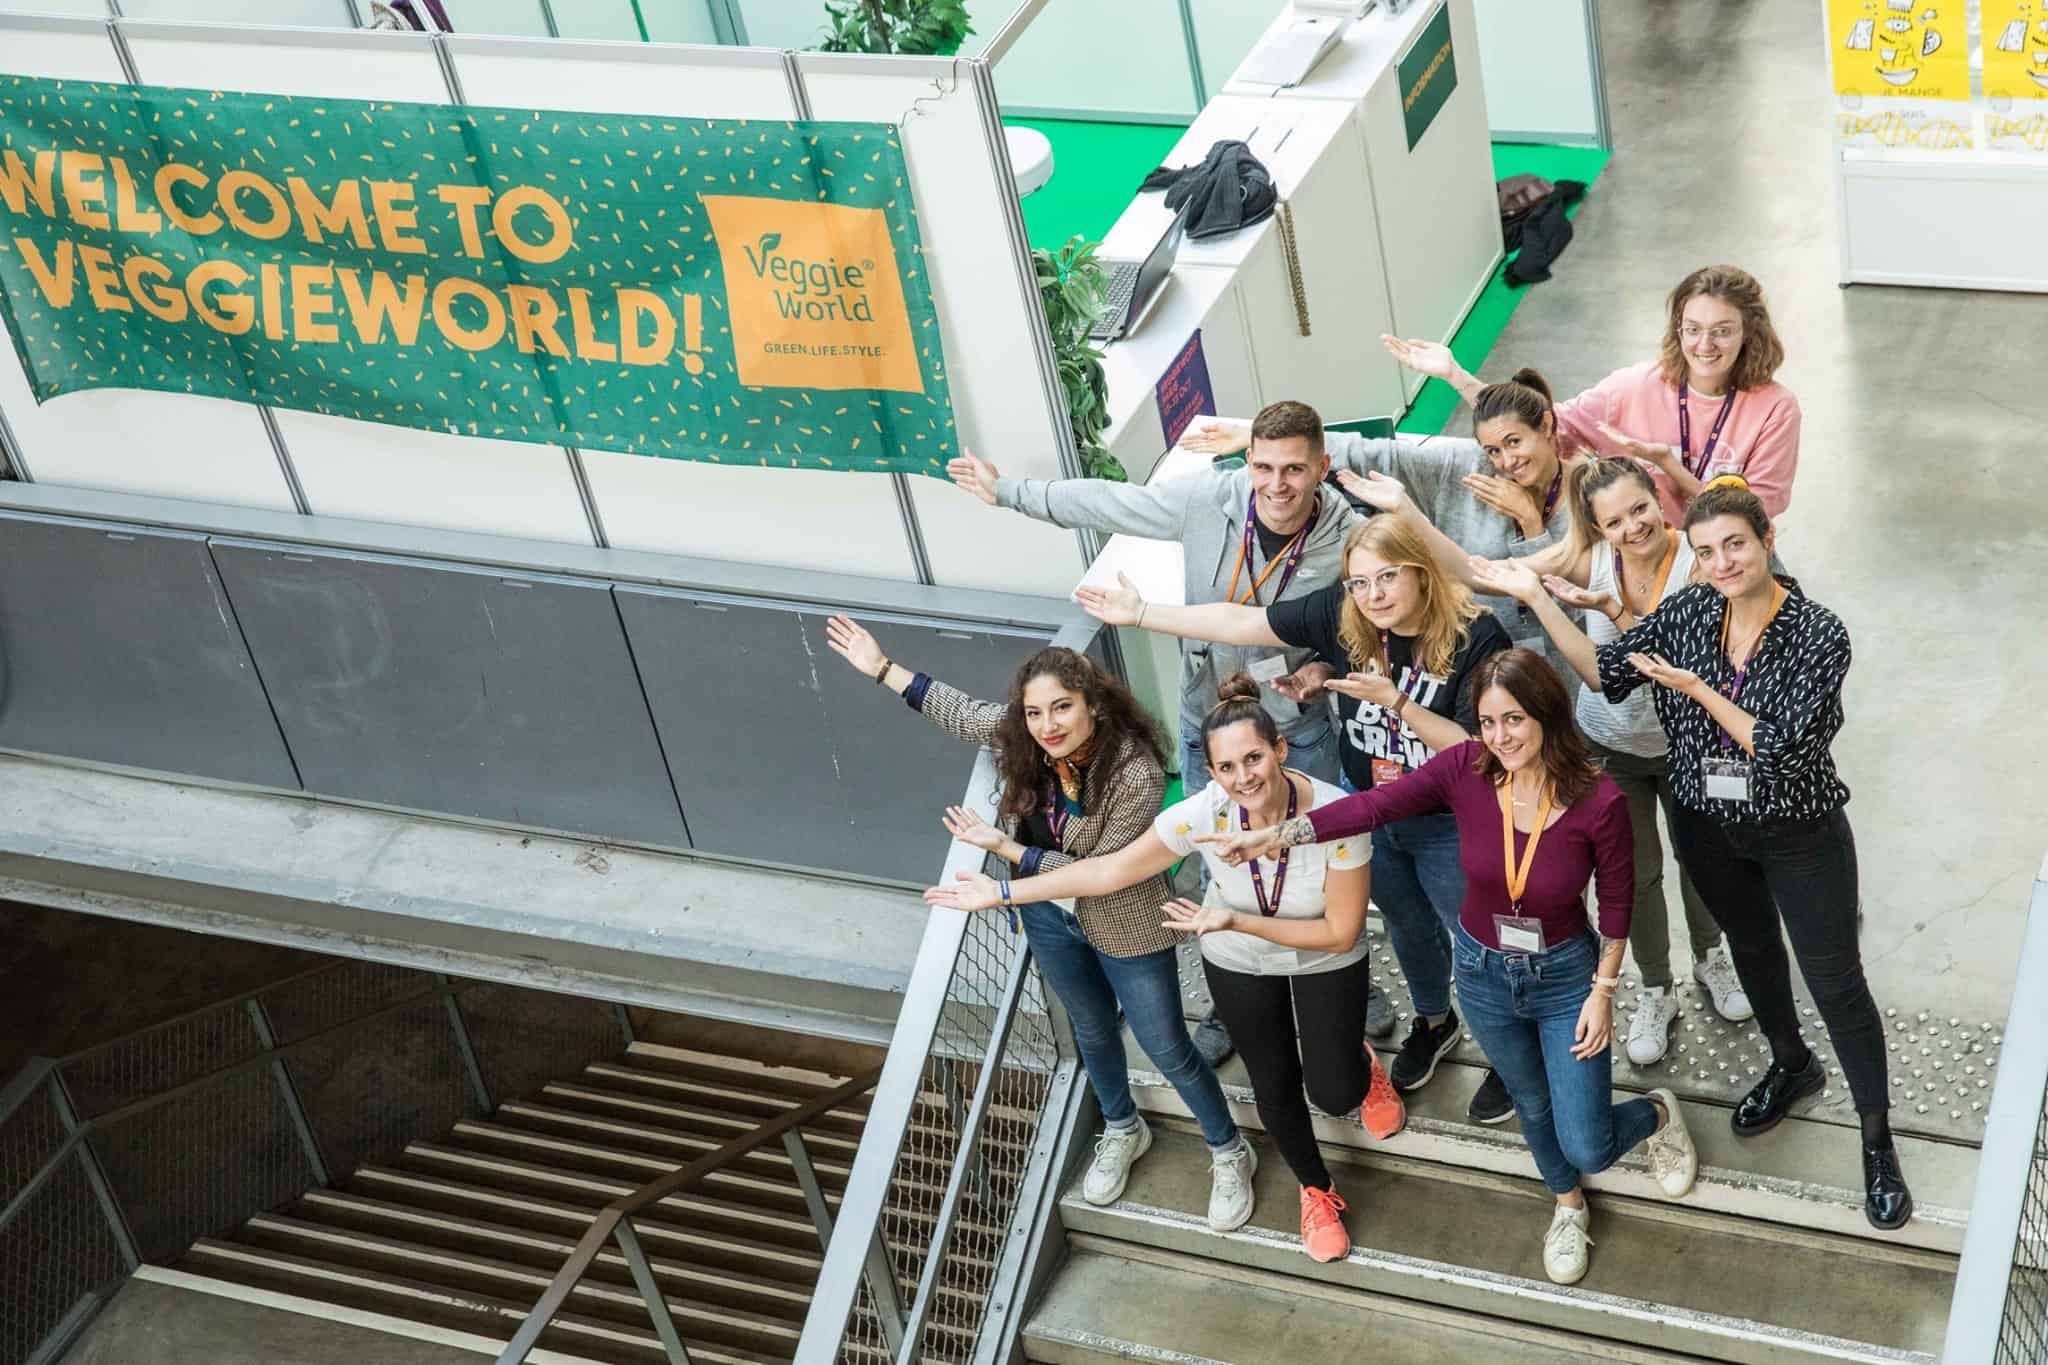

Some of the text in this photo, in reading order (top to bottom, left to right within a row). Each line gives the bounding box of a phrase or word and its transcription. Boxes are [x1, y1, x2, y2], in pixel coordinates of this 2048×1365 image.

[0, 150, 573, 264] WELCOME TO
[13, 237, 704, 375] VEGGIEWORLD!
[774, 289, 875, 322] World
